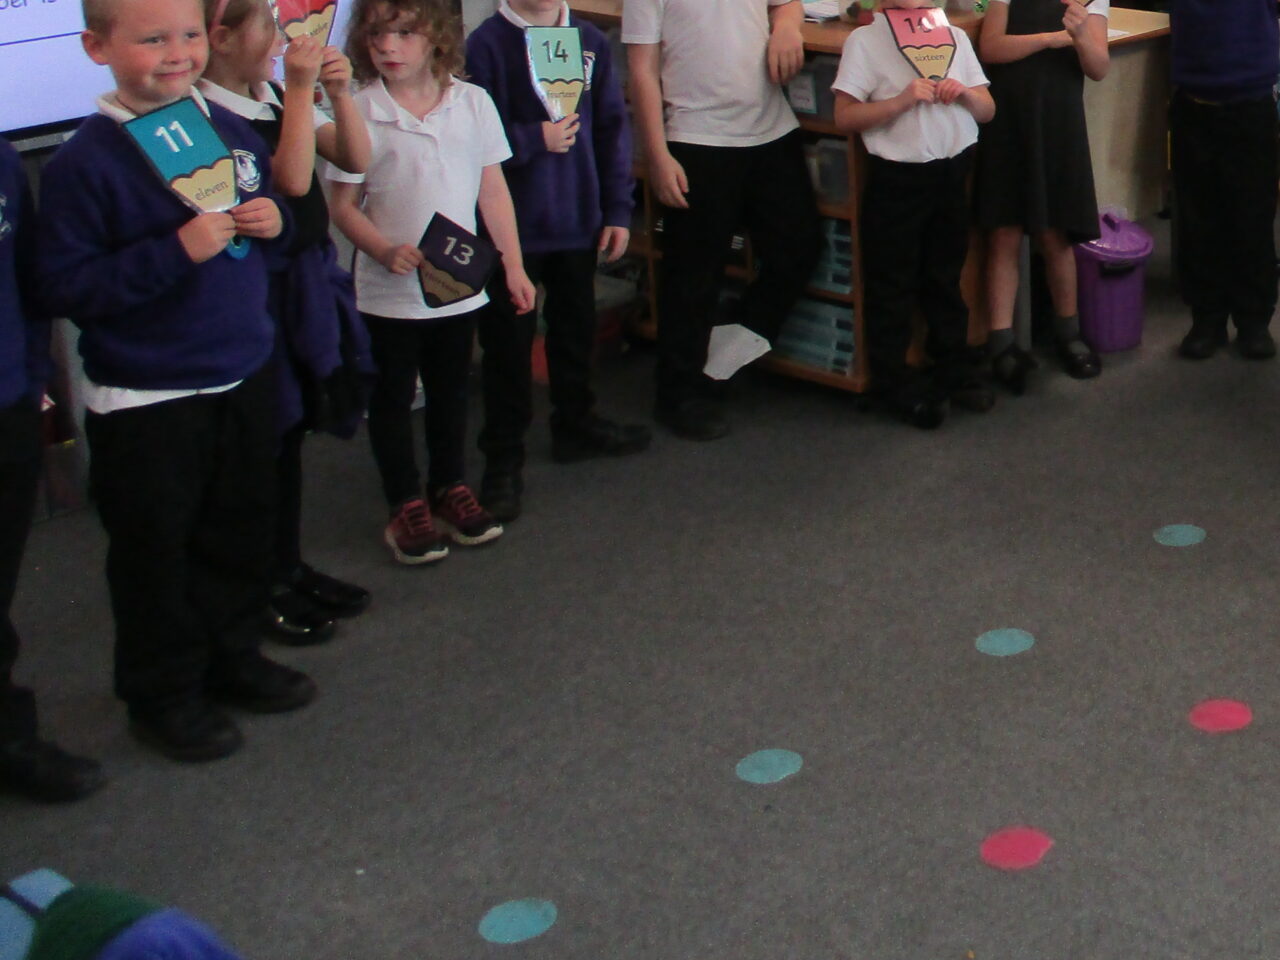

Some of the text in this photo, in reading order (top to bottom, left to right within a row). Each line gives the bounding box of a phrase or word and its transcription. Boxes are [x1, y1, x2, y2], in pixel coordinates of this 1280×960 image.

[541, 40, 569, 64] 14
[914, 54, 945, 62] sixteen
[153, 119, 195, 153] 11
[194, 179, 230, 201] eleven
[443, 236, 475, 266] 13
